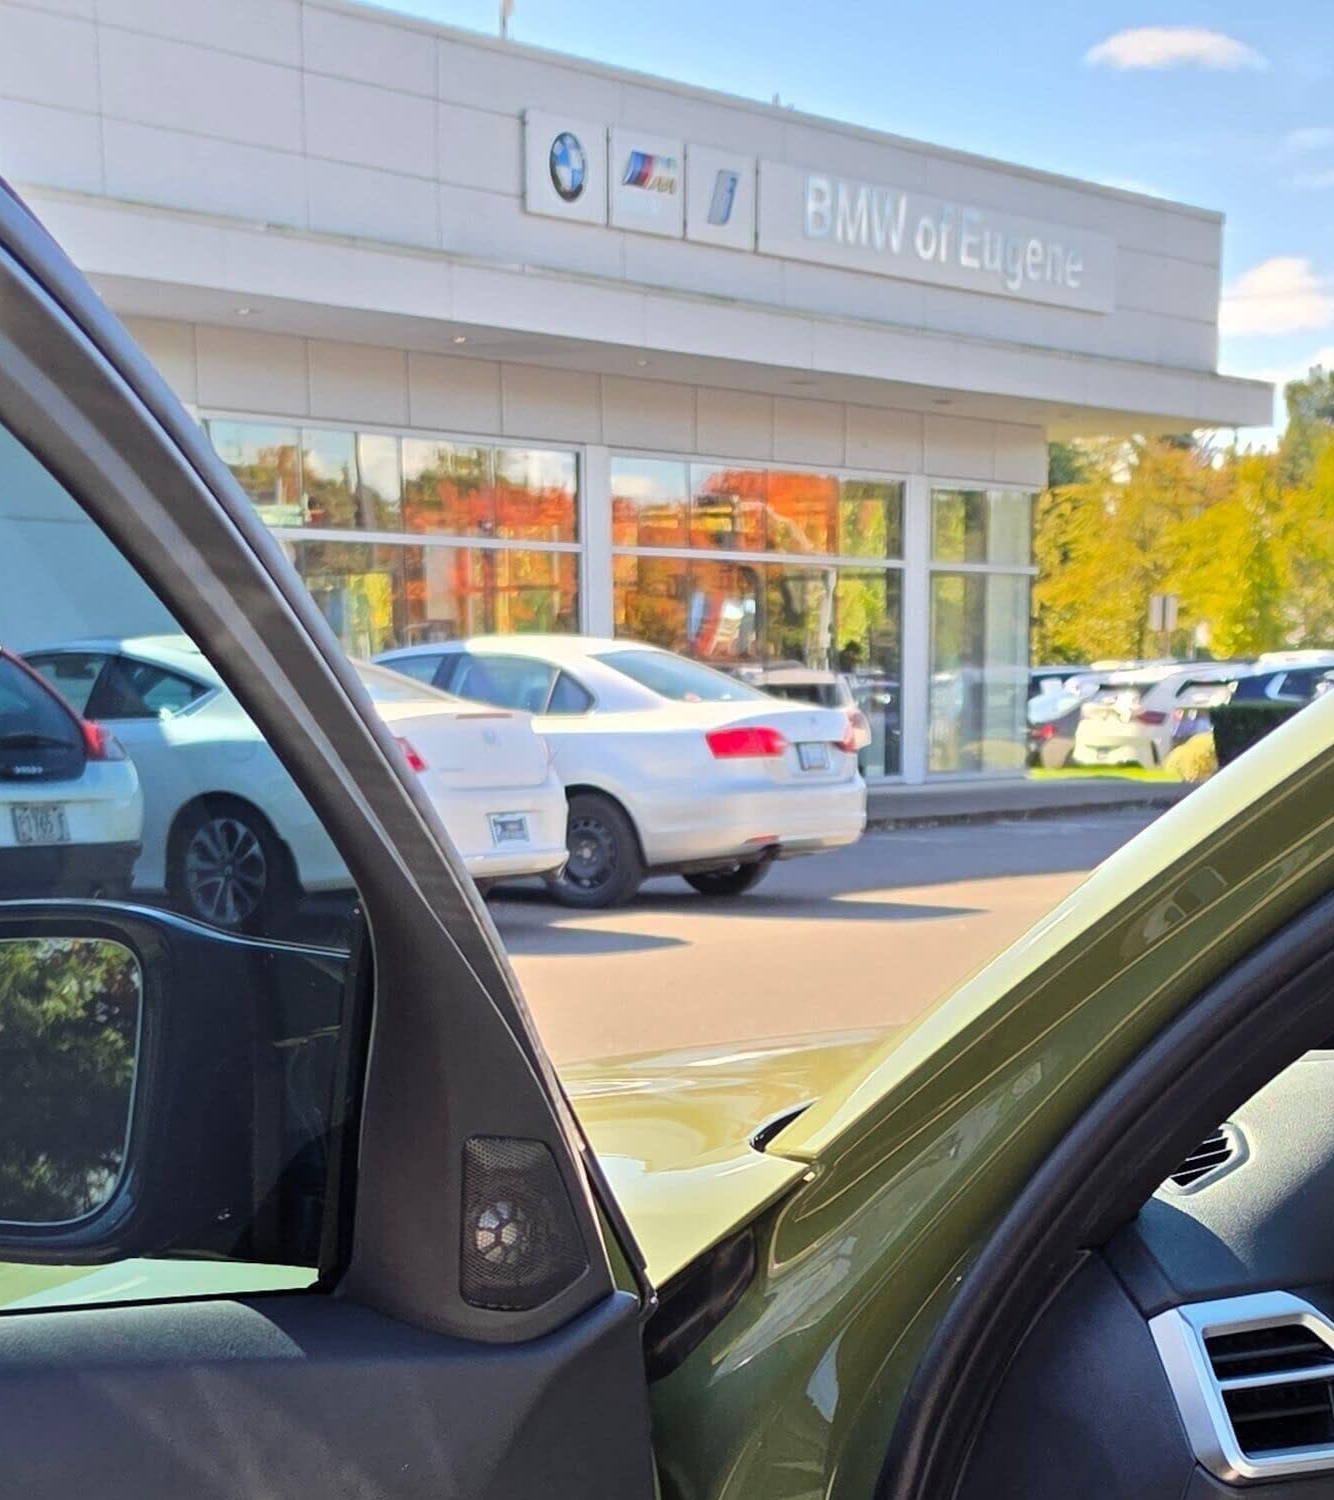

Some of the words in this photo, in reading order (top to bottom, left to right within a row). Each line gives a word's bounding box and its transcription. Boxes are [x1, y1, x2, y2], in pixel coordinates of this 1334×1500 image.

[805, 175, 908, 254] BMW
[914, 202, 955, 263] of
[960, 206, 1085, 291] Eugene
